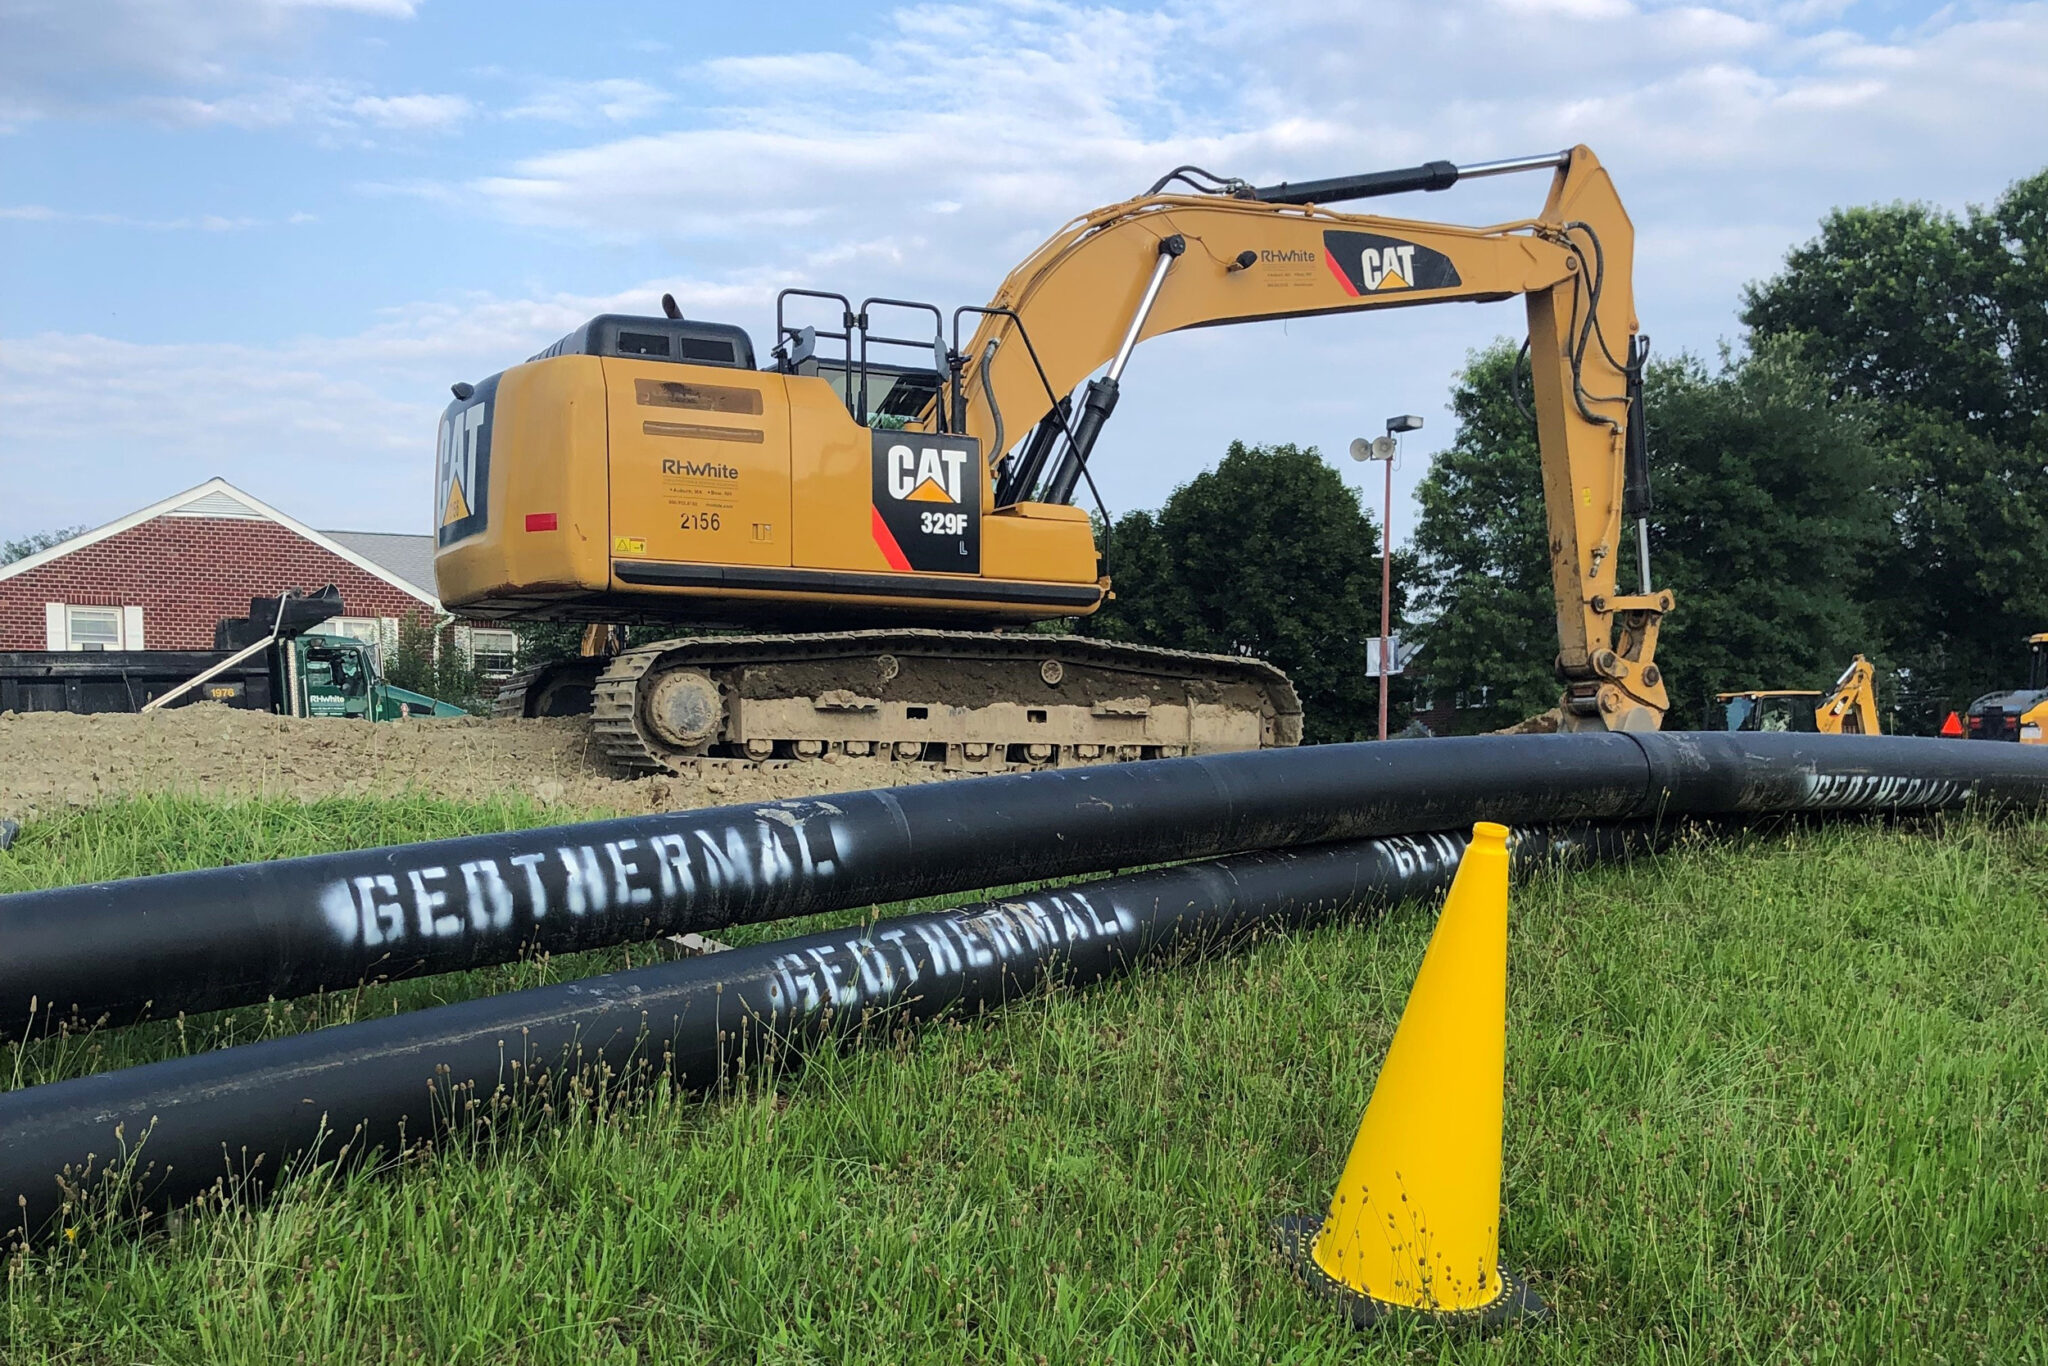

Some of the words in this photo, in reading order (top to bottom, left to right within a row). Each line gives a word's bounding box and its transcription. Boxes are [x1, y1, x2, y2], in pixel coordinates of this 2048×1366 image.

[1260, 249, 1316, 263] RHWhite
[1361, 244, 1416, 291] CAT
[439, 402, 485, 525] CAT
[662, 459, 738, 479] RHWhite
[887, 444, 968, 504] CAT
[680, 512, 721, 531] 2156
[920, 511, 968, 535] 329F
[959, 540, 968, 555] L
[309, 694, 345, 703] RHWhite
[354, 820, 836, 947] GEOTHERMAL
[772, 892, 1120, 1010] GEOTHERMAL
